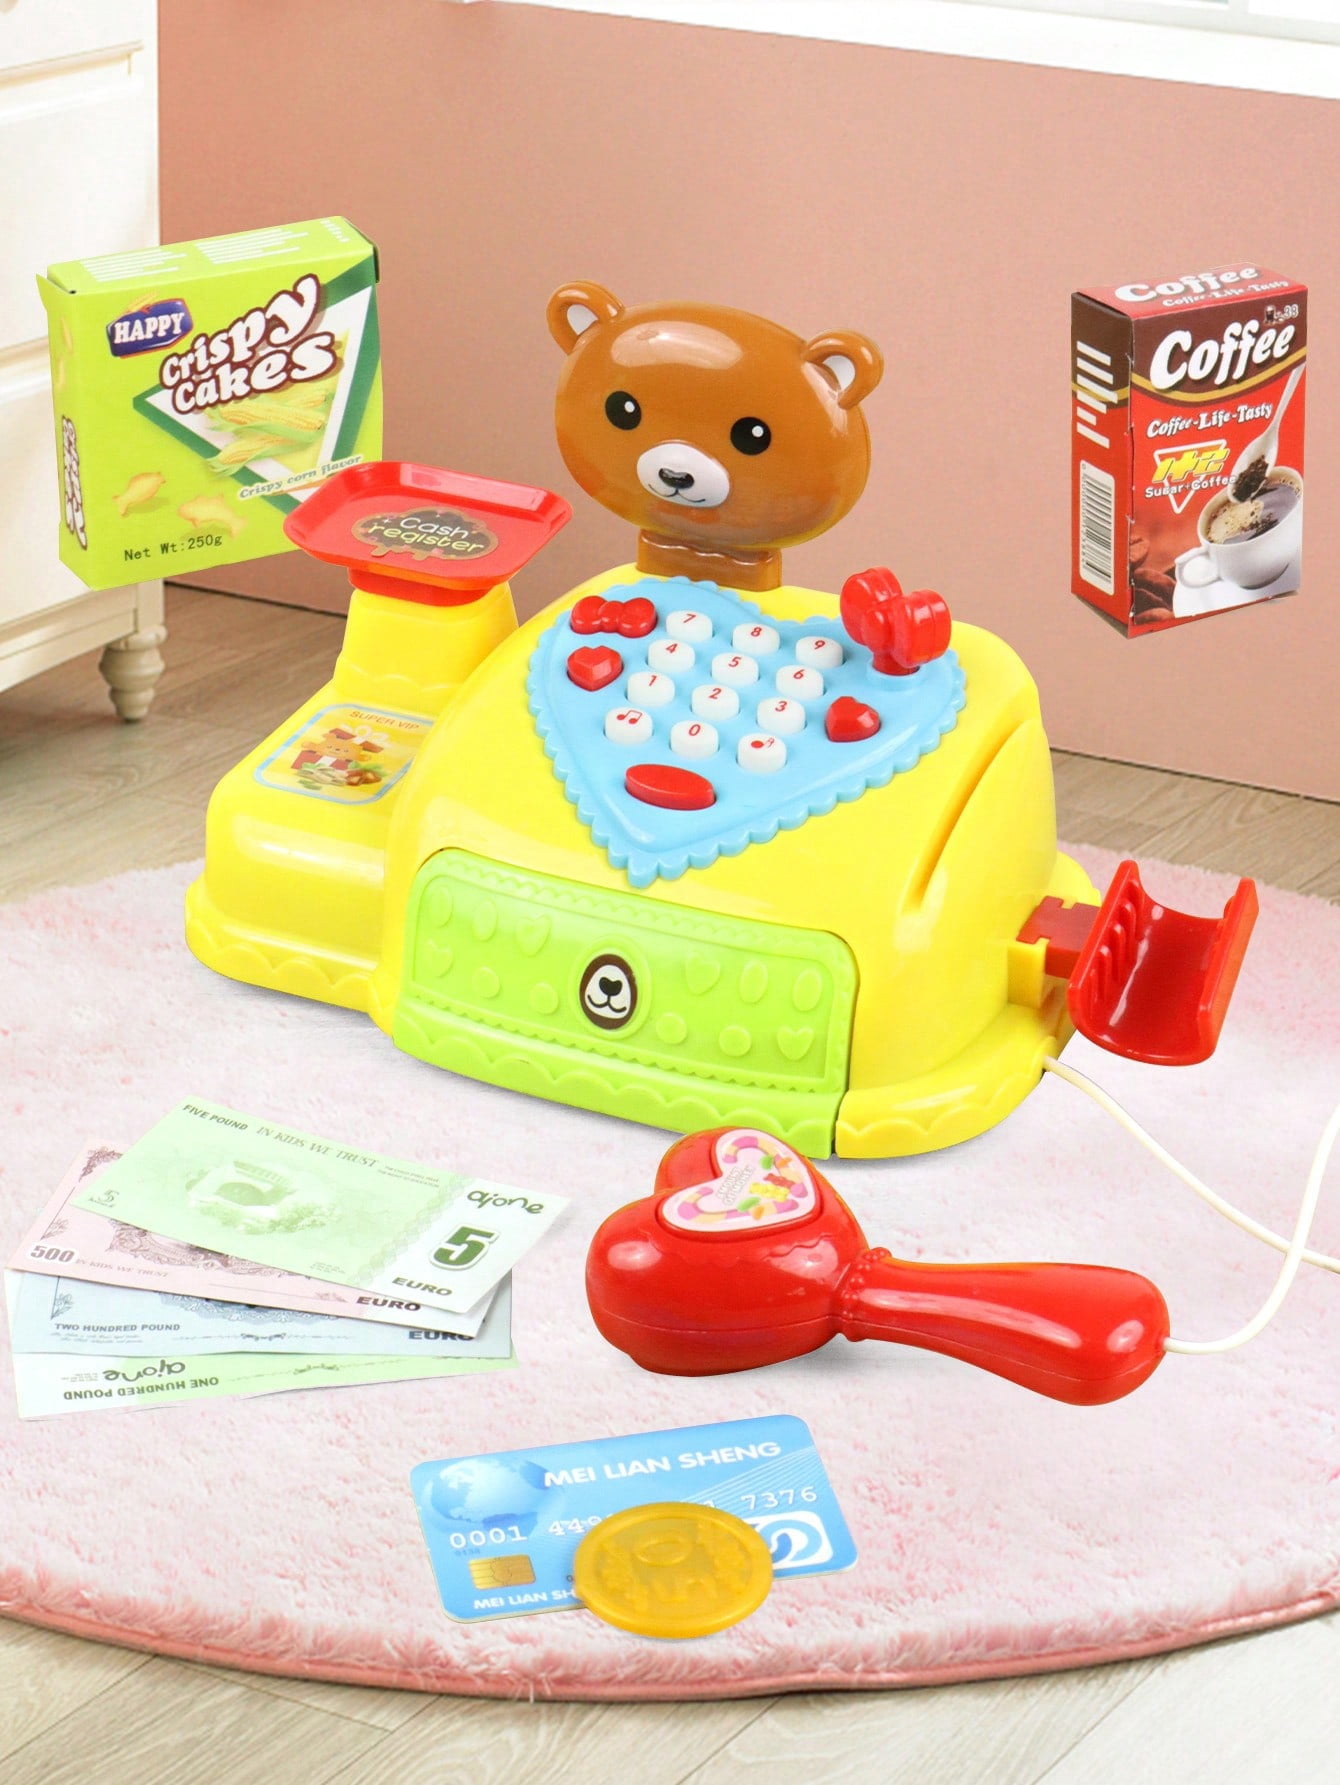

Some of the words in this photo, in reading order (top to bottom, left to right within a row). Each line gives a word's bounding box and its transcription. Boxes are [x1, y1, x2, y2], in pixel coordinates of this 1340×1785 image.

[1115, 267, 1259, 303] Coffee
[113, 311, 186, 345] HAPPY
[161, 274, 320, 389] Crispy
[1150, 318, 1295, 391] Coffee
[173, 332, 337, 415] Cakes
[240, 480, 283, 499] Crispy
[287, 470, 318, 485] corn
[320, 456, 361, 476] flavor
[400, 517, 469, 540] Cash
[368, 522, 485, 554] register
[124, 547, 151, 561] Net
[681, 613, 697, 625] 7
[750, 626, 764, 638] 8
[666, 642, 679, 655] 4
[812, 639, 826, 651] 9
[728, 656, 740, 668] 5
[648, 674, 657, 687] 1
[793, 668, 805, 681] 6
[708, 687, 722, 700] 2
[774, 701, 788, 713] 3
[350, 711, 395, 725] SUPER
[398, 721, 420, 730] VIP
[688, 724, 701, 737] 0
[182, 1104, 210, 1120] FIVE
[209, 1114, 249, 1131] POUND
[256, 1126, 274, 1138] IN
[274, 1132, 305, 1148] KIDS
[308, 1142, 332, 1155] WE
[335, 1151, 380, 1169] TRUST
[30, 1245, 75, 1263] 500
[432, 1225, 496, 1267] 5
[392, 1276, 452, 1296] EURO
[356, 1296, 421, 1312] EURO
[55, 1322, 80, 1331] TWO
[83, 1323, 137, 1333] HUNDRED
[141, 1323, 181, 1331] POUND
[118, 1381, 186, 1397] HUNDRED
[190, 1376, 219, 1389] ONE
[63, 1388, 113, 1401] POUND
[544, 1466, 596, 1489] MEI
[603, 1455, 673, 1481] LIAN
[679, 1441, 782, 1471] SHENG
[449, 1525, 528, 1549] 0001
[740, 1486, 818, 1511] 7376
[473, 1598, 505, 1610] MEI
[507, 1592, 548, 1606] LIAN
[550, 1589, 577, 1601] SH
